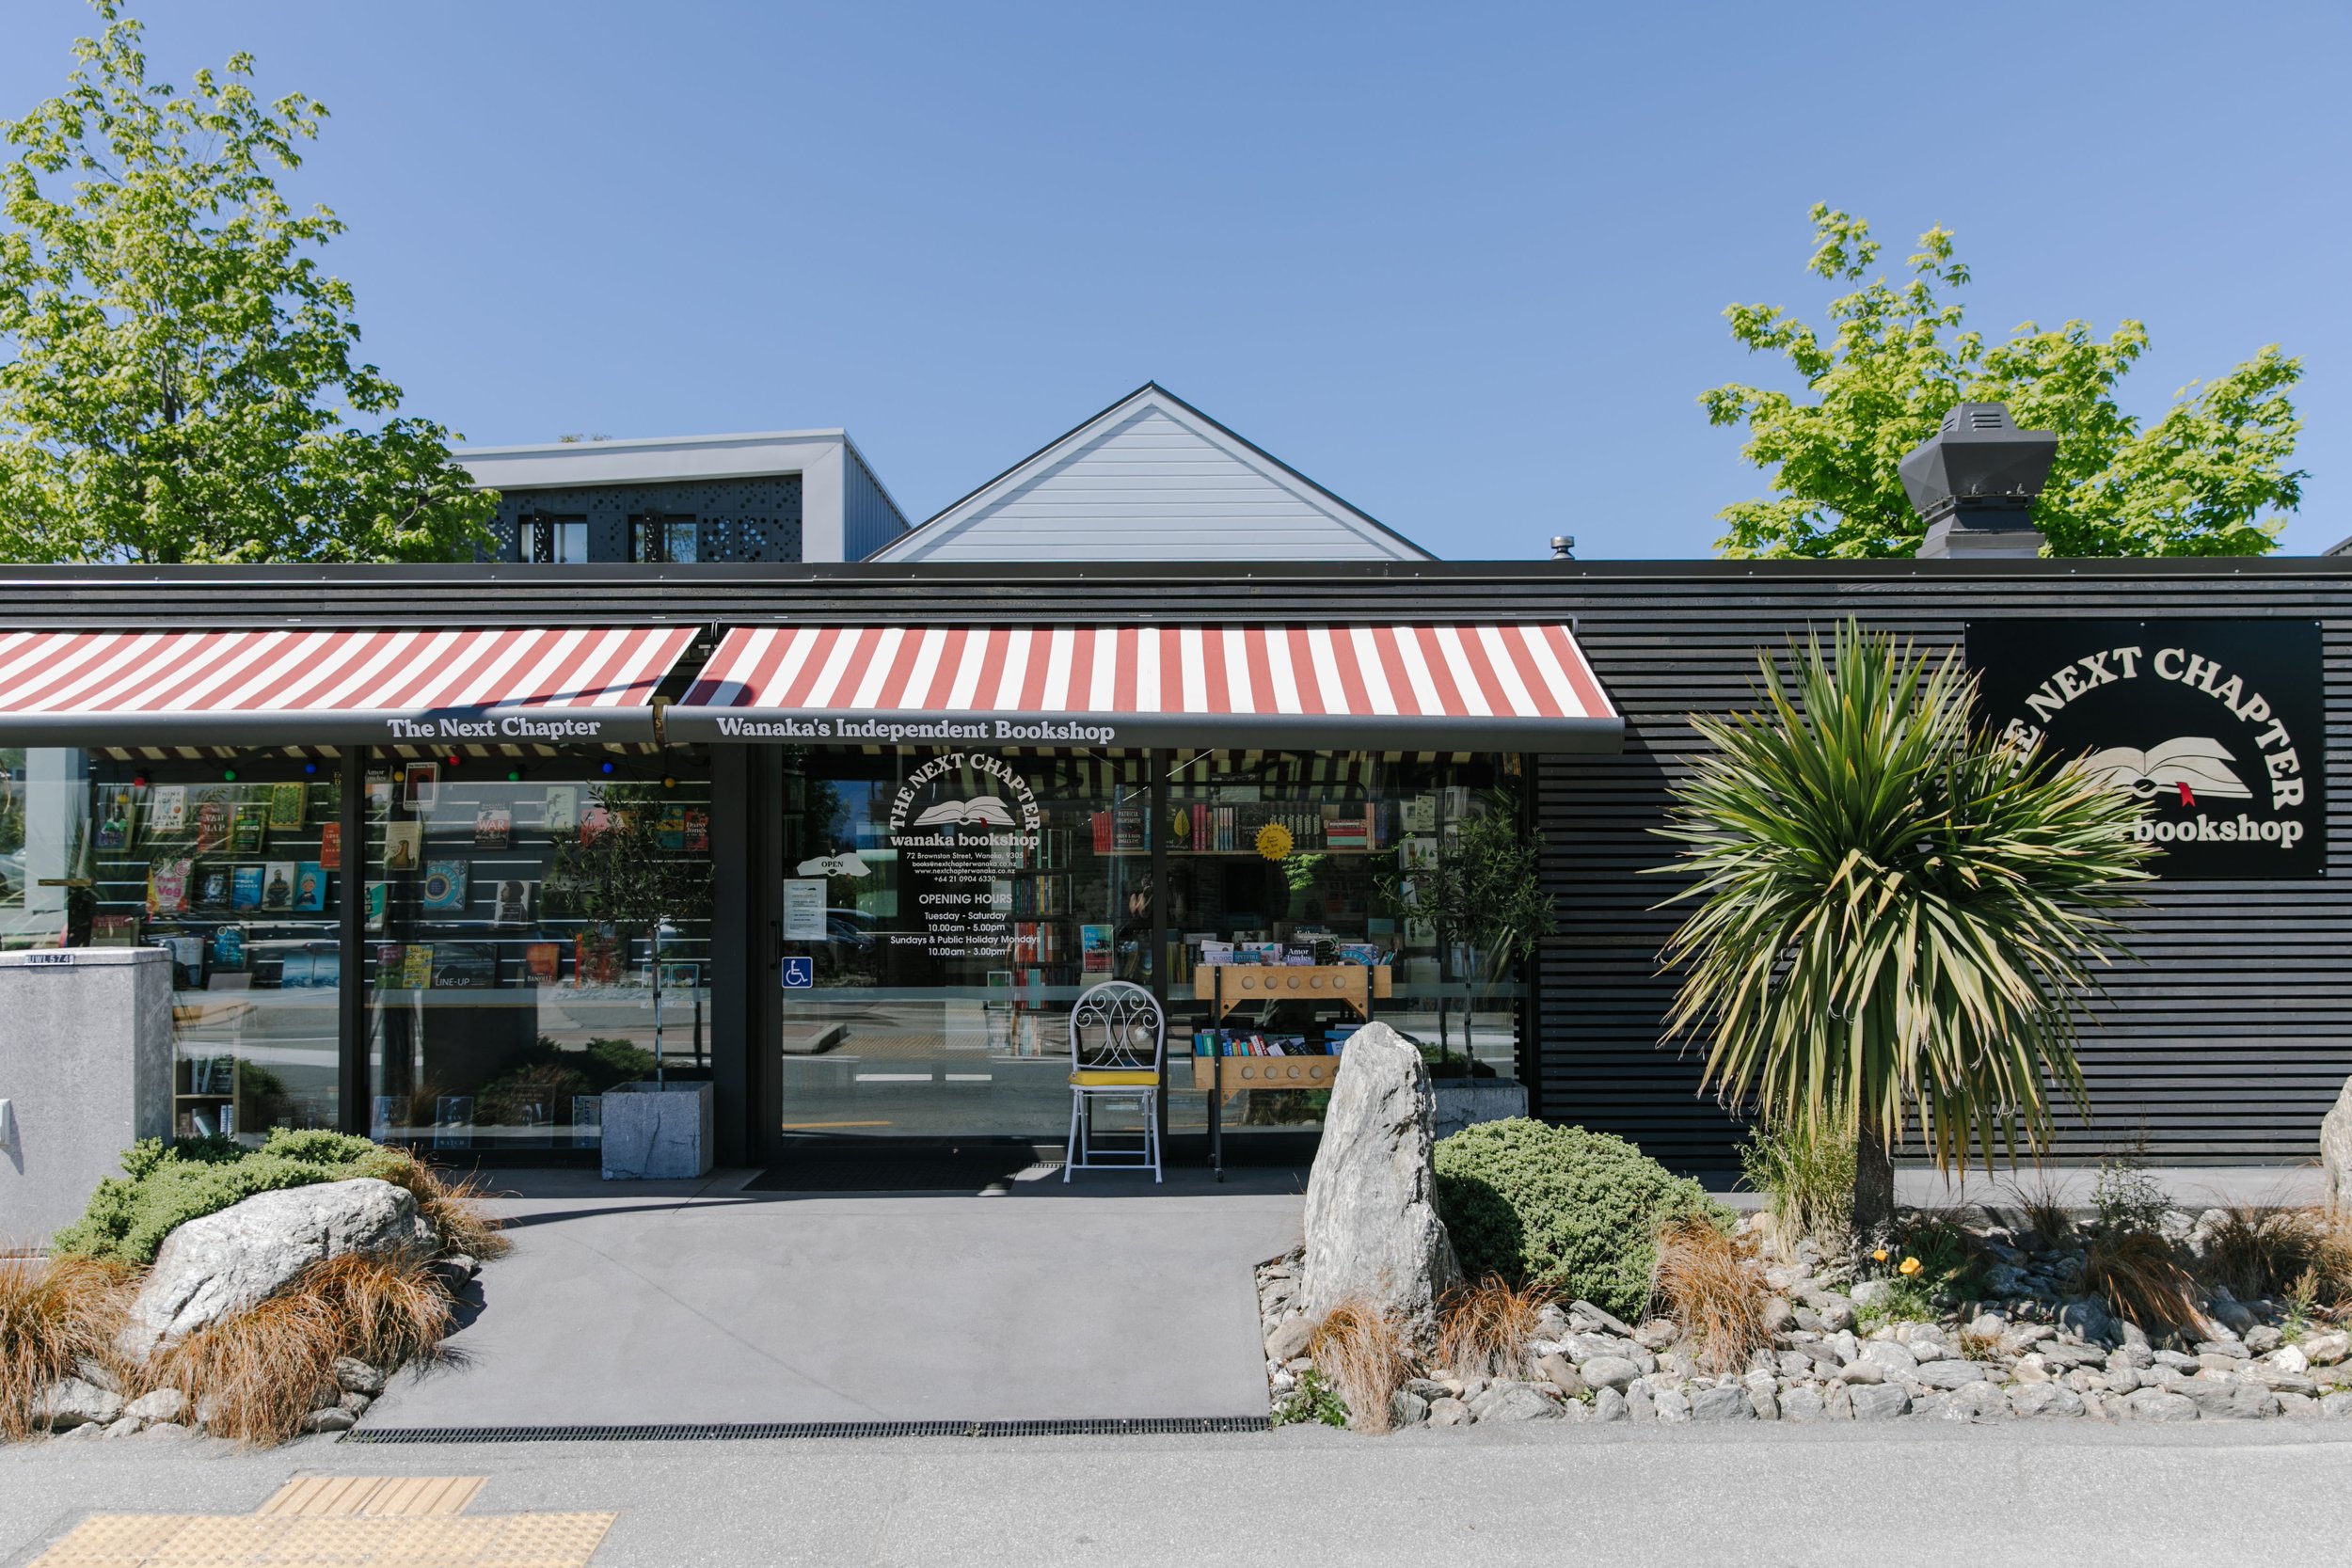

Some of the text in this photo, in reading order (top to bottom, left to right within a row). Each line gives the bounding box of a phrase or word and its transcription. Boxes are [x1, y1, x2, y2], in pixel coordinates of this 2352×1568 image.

[387, 716, 601, 740] The Next Chapter
[716, 717, 1115, 745] Wanaka's Independent Bookshop
[2025, 645, 2142, 723] NEXT
[2153, 648, 2304, 810] CHAPTER
[889, 752, 1041, 832] THE NEXT CHAPTER
[479, 819, 505, 831] WAR
[2135, 814, 2304, 848] bookshop
[889, 832, 1040, 849] wanaka bookshop
[952, 851, 973, 860] Street,
[912, 860, 1017, 868] books@nextchapterwanaka.co.nz
[157, 885, 182, 898] Veg
[918, 894, 1013, 904] OPENING HOURS
[924, 911, 960, 921] Tuesday
[968, 911, 1007, 921] Saturday
[928, 924, 965, 932] 10.00am
[973, 924, 1006, 933] 5.00pm
[890, 935, 1041, 945] Sundays & Public Holiday Mondays
[928, 947, 965, 956] 10.00am
[973, 947, 1006, 957] 3.00pm
[1286, 954, 1311, 962] Towles
[435, 977, 470, 987] LINE-UP
